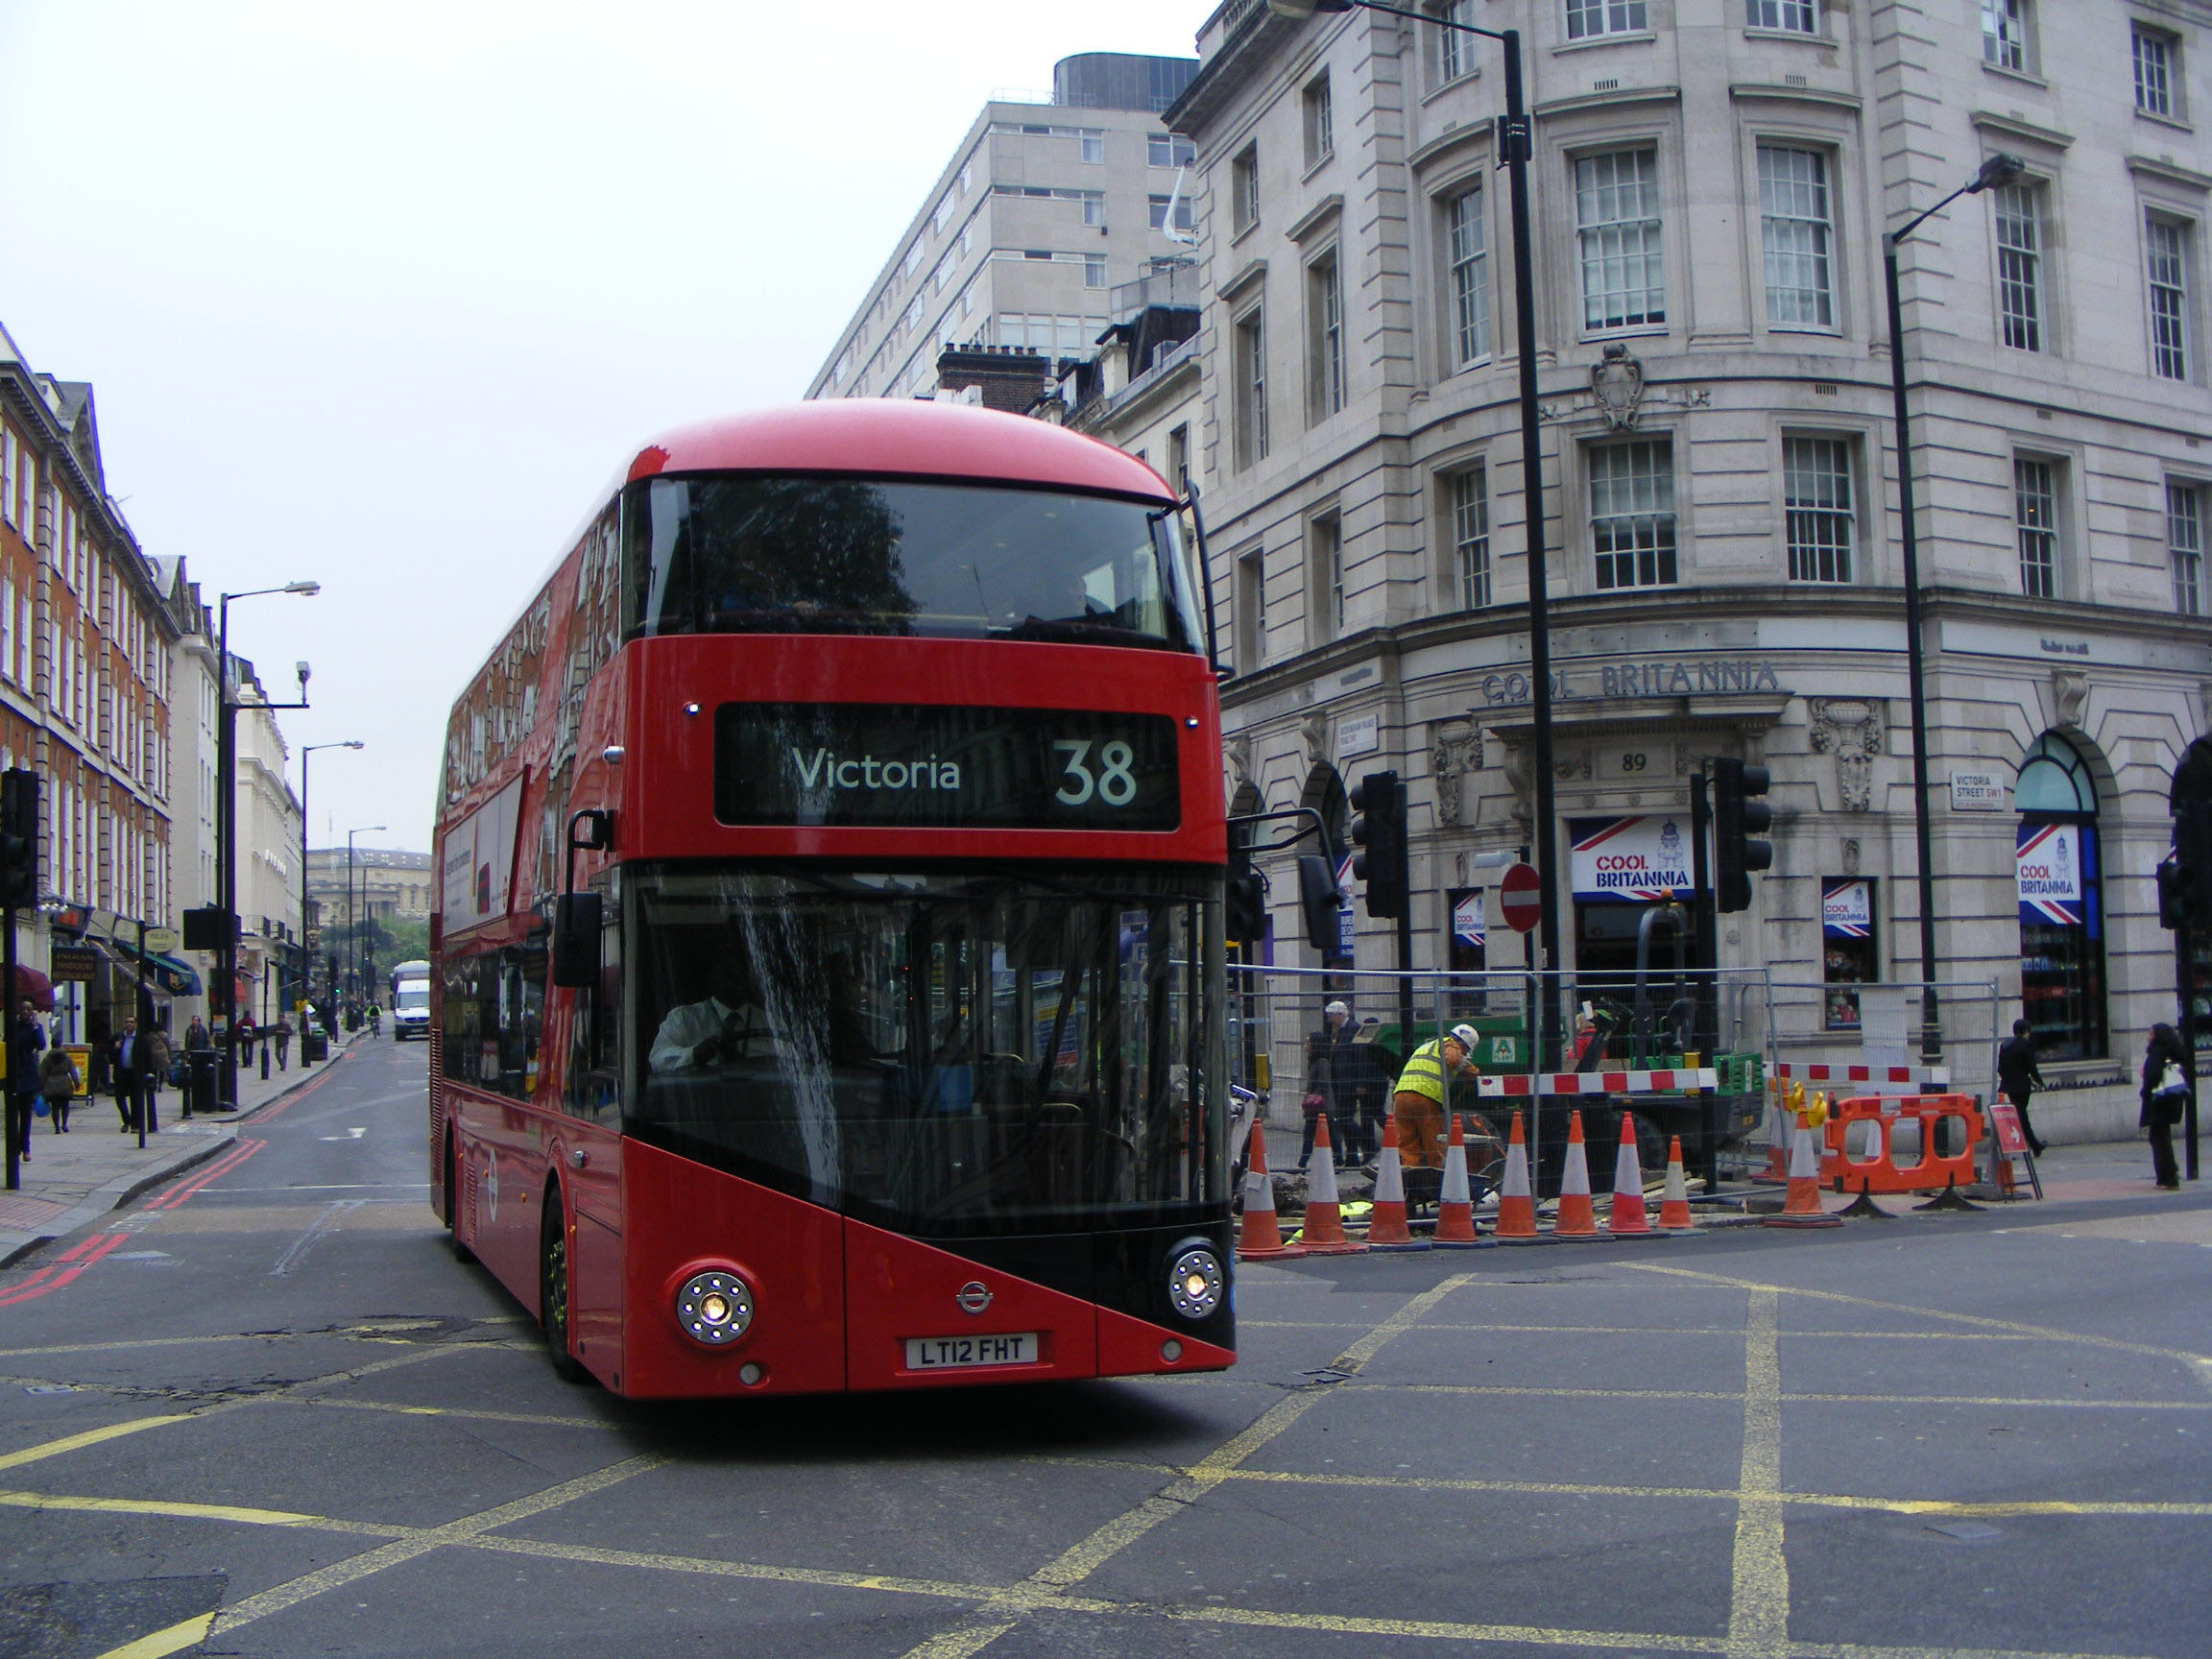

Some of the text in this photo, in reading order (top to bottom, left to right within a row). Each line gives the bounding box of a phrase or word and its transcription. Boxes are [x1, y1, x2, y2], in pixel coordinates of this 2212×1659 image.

[1602, 660, 1779, 692] BRITANNIA
[1622, 753, 1647, 771] 89
[791, 740, 1137, 806] Victoria 38
[1956, 776, 1990, 785] VICTORIA
[1957, 787, 2002, 798] STREET SW1
[1596, 854, 1649, 871] COOL
[1597, 871, 1689, 887] BRITANNIA
[2020, 865, 2051, 879] COOL
[2021, 880, 2074, 895] BRITANNIA
[1825, 913, 1868, 922] BRITANNIA
[922, 1337, 1022, 1364] LT12 FHT
